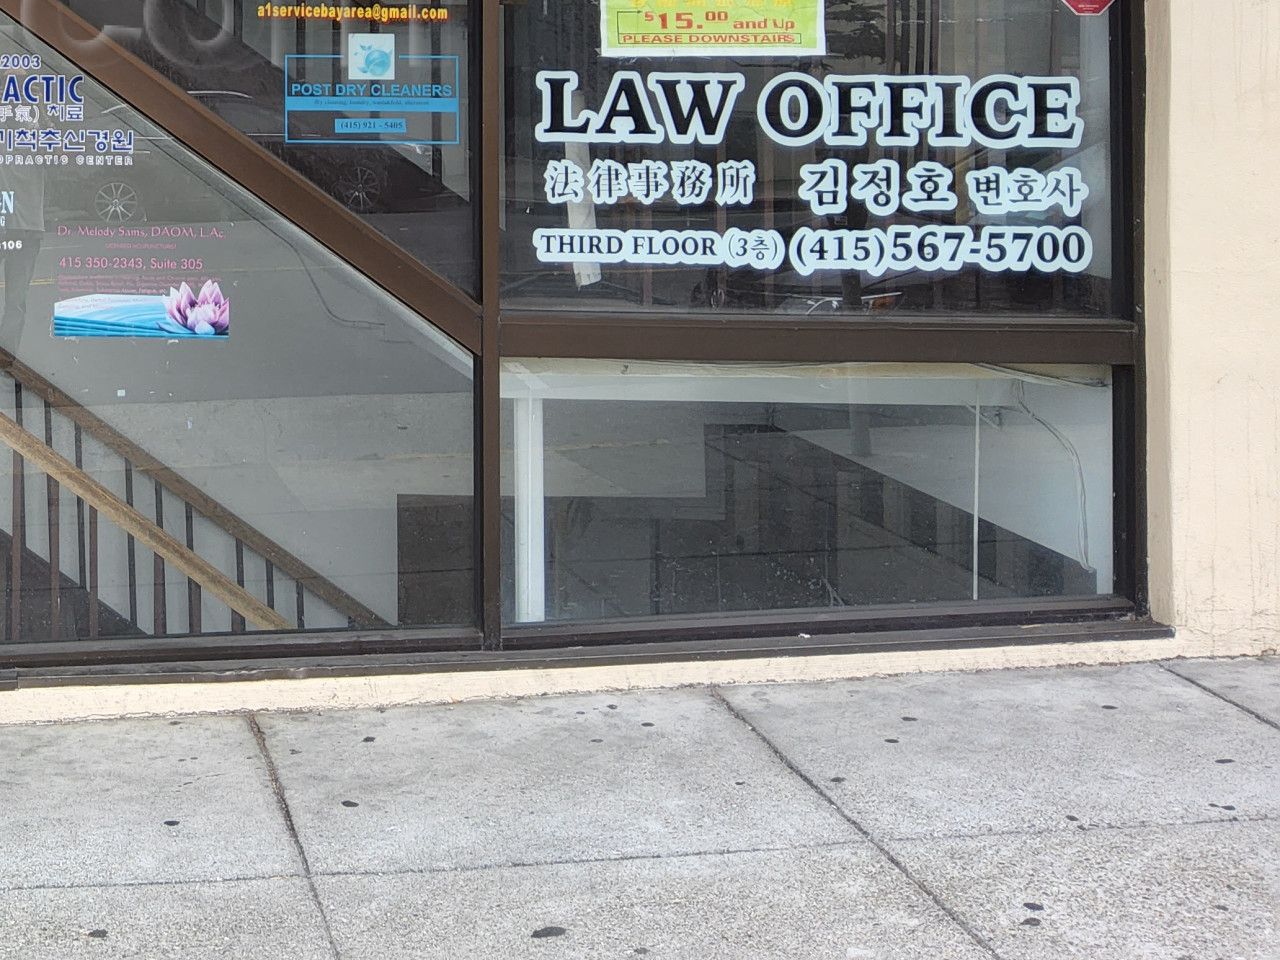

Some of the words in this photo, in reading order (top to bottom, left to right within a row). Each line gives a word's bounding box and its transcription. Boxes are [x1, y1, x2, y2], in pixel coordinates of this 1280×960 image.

[257, 3, 449, 24] a1servicebayarea@gmail.com
[733, 18, 768, 30] and
[773, 18, 796, 31] Up
[623, 35, 683, 44] PLEASE
[688, 34, 795, 43] DOWNSTAIRS
[291, 83, 331, 97] POST
[335, 83, 366, 97] DRY
[371, 83, 452, 97] CLEANERS
[47, 104, 84, 121] 치료
[539, 75, 741, 140] LAW
[761, 75, 1080, 144] OFFICE
[76, 155, 133, 166] CENTER
[547, 161, 754, 204] 法律事務所
[802, 162, 955, 212] 김정호
[969, 168, 1085, 213] 변호사
[78, 225, 115, 240] Melody
[537, 232, 624, 258] THIRD
[629, 233, 719, 259] FLOOR
[726, 232, 781, 264] (3층)
[793, 228, 1089, 271] (415)567-5700
[59, 257, 82, 269] 415
[150, 258, 177, 269] Suite
[181, 258, 204, 270] 305
